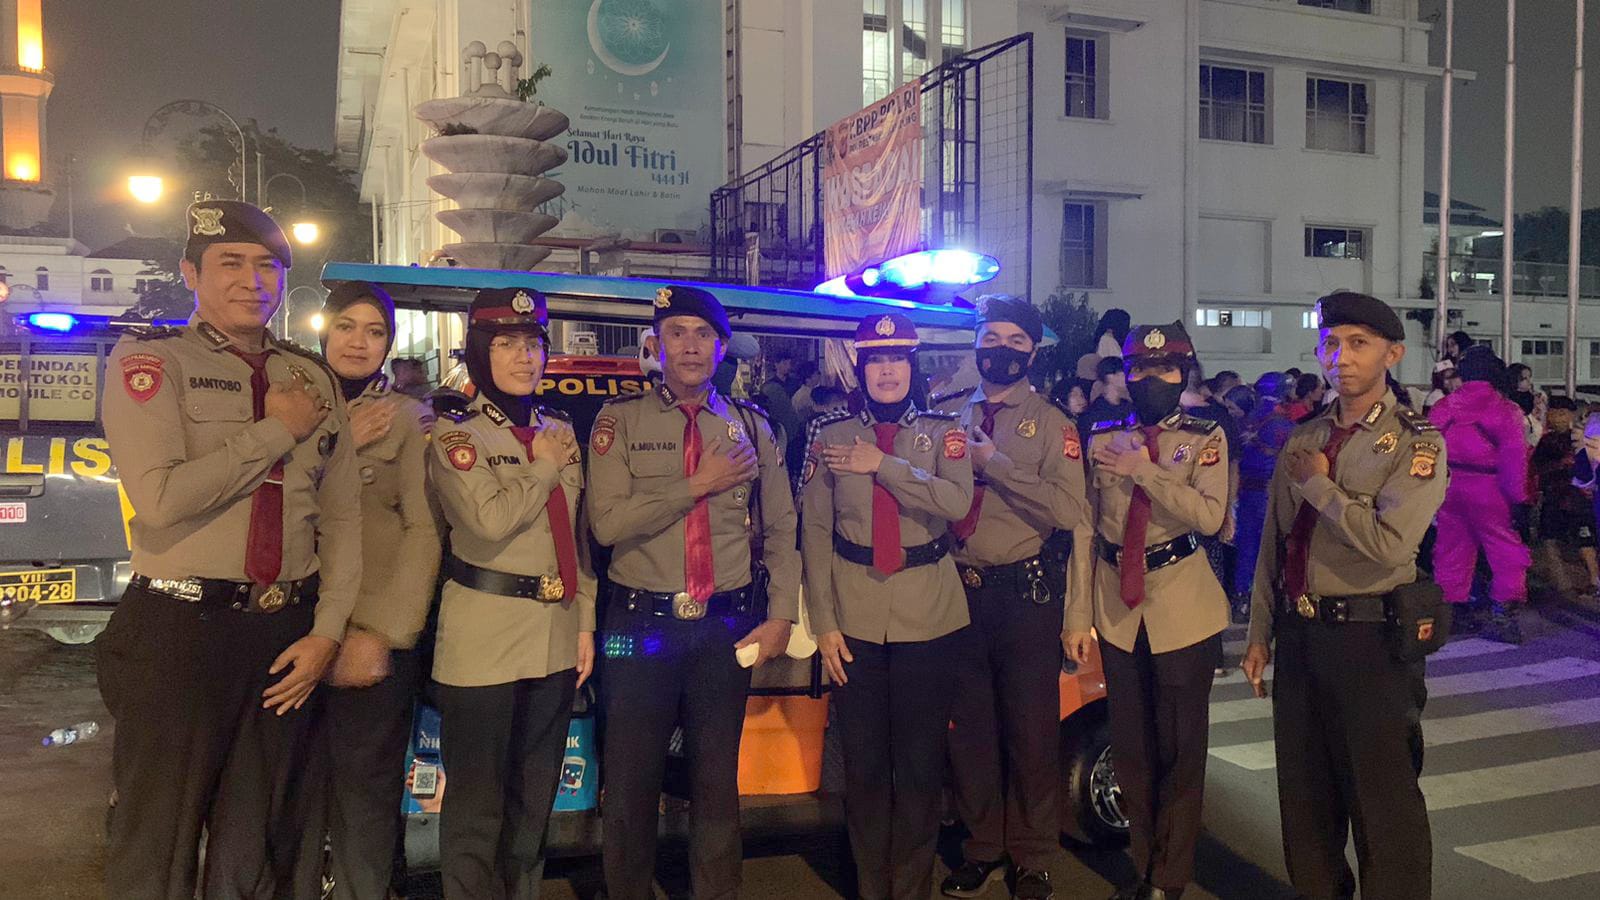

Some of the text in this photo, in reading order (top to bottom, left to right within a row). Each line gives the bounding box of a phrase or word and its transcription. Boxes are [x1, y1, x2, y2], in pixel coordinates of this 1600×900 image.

[567, 128, 645, 144] Selamat Hari Raya
[567, 140, 676, 171] Idul Fitri
[652, 173, 675, 185] 1444
[577, 185, 605, 194] Mohon
[607, 187, 627, 196] Maaf
[629, 189, 650, 197] Lahir
[660, 191, 681, 200] Batin
[0, 360, 89, 372] EINDAK
[0, 373, 93, 386] RTOKOL
[189, 377, 242, 392] SANTOSO
[630, 442, 676, 451] A.MULYADI
